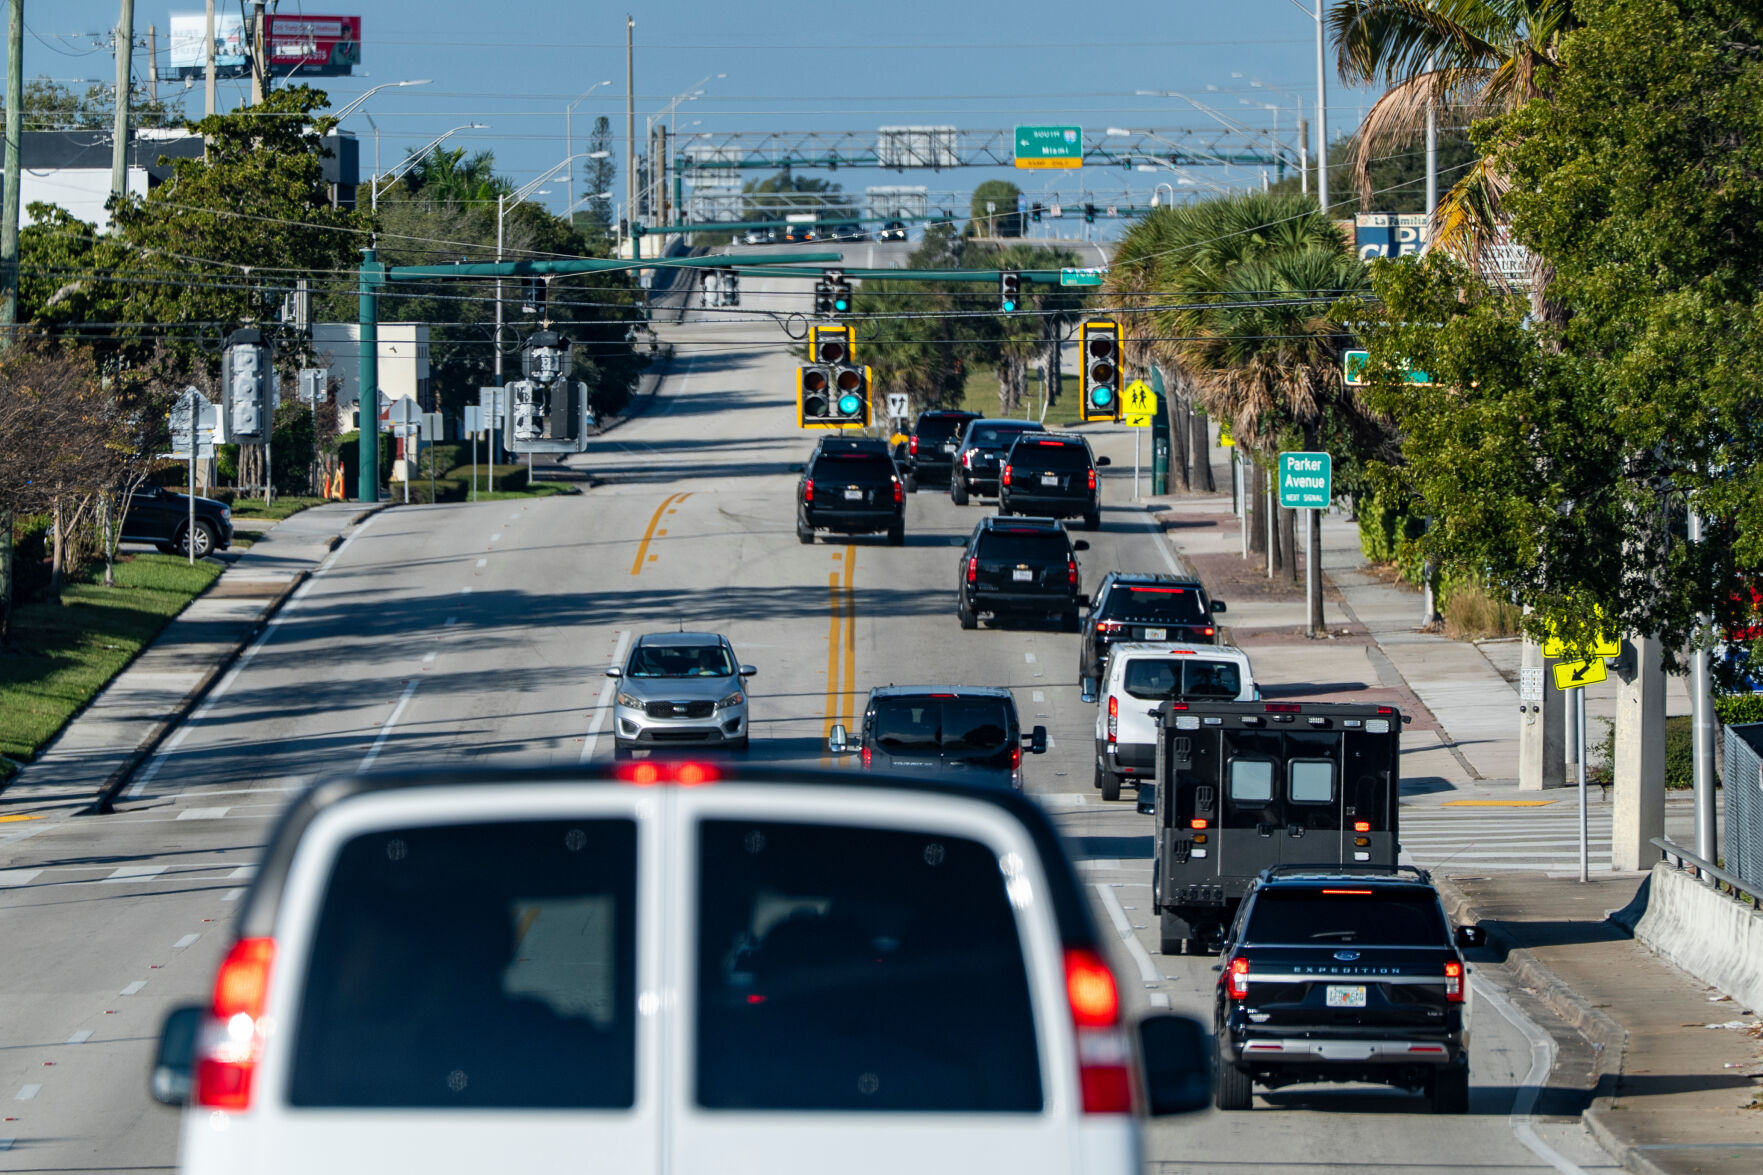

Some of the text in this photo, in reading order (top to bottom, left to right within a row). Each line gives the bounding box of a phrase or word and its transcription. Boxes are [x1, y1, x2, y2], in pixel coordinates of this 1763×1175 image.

[1033, 130, 1060, 139] SOUTH
[1041, 146, 1069, 155] Miami
[1374, 216, 1386, 225] La
[1287, 456, 1322, 471] Parker
[1285, 473, 1325, 488] Avenue
[1293, 965, 1400, 975] EXPEDITION
